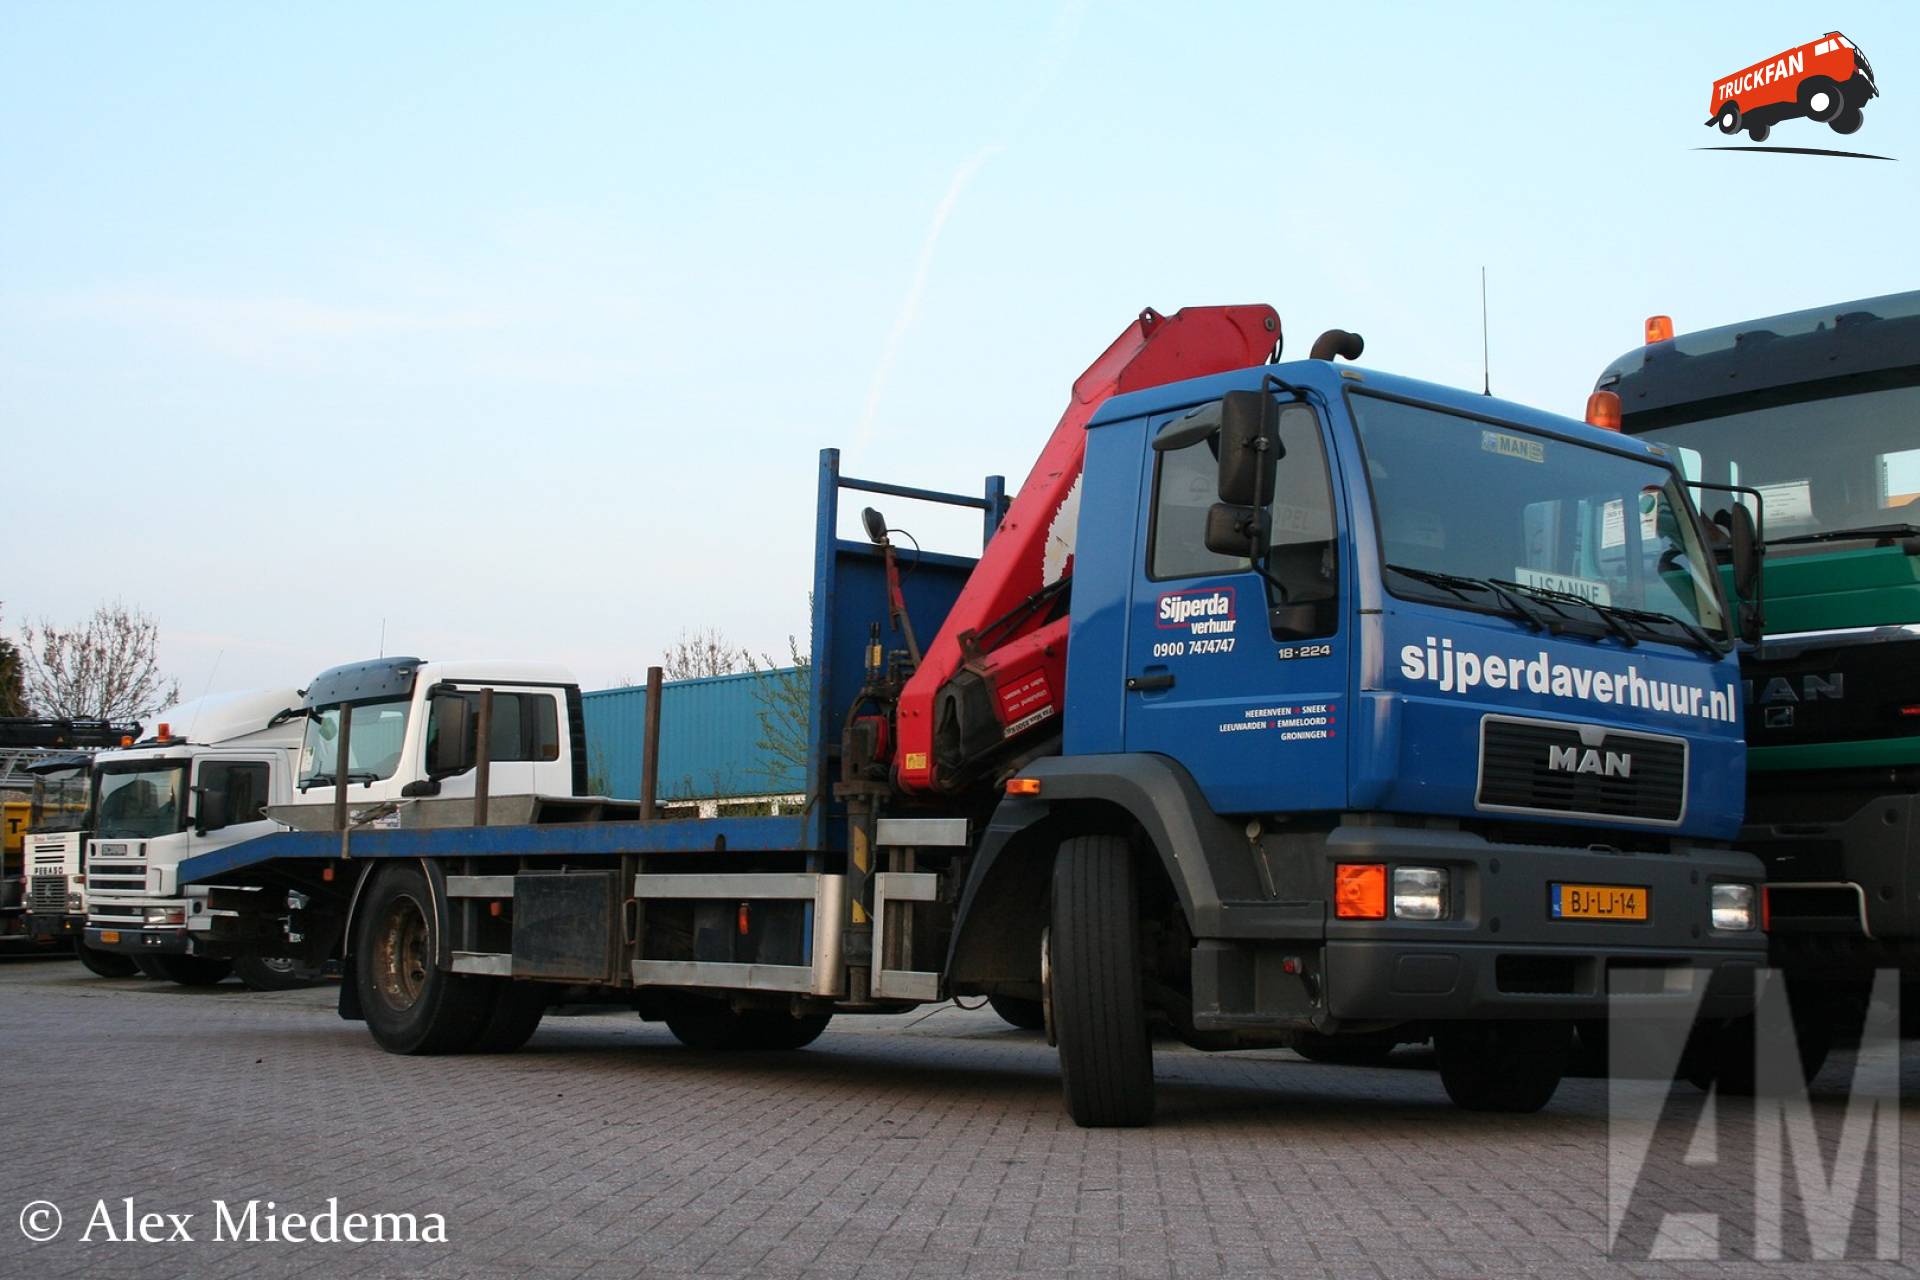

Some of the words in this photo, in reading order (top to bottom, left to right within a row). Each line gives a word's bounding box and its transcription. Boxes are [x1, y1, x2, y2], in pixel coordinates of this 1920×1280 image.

[1160, 593, 1229, 623] Sijperda
[1191, 619, 1236, 635] verhuur
[1153, 642, 1184, 657] 0900
[1189, 638, 1235, 654] 7474747
[1400, 636, 1736, 723] sijperdaverhuur.nl
[1245, 707, 1291, 718] HEERENVEEN
[1302, 705, 1326, 714] SNEEK
[1219, 721, 1267, 732] LEEUWARDEN
[1277, 717, 1327, 728] EMMELOORD
[1281, 730, 1327, 741] GRONINGEN
[1549, 744, 1631, 778] MAN
[1571, 890, 1636, 914] BJ-LJ-14
